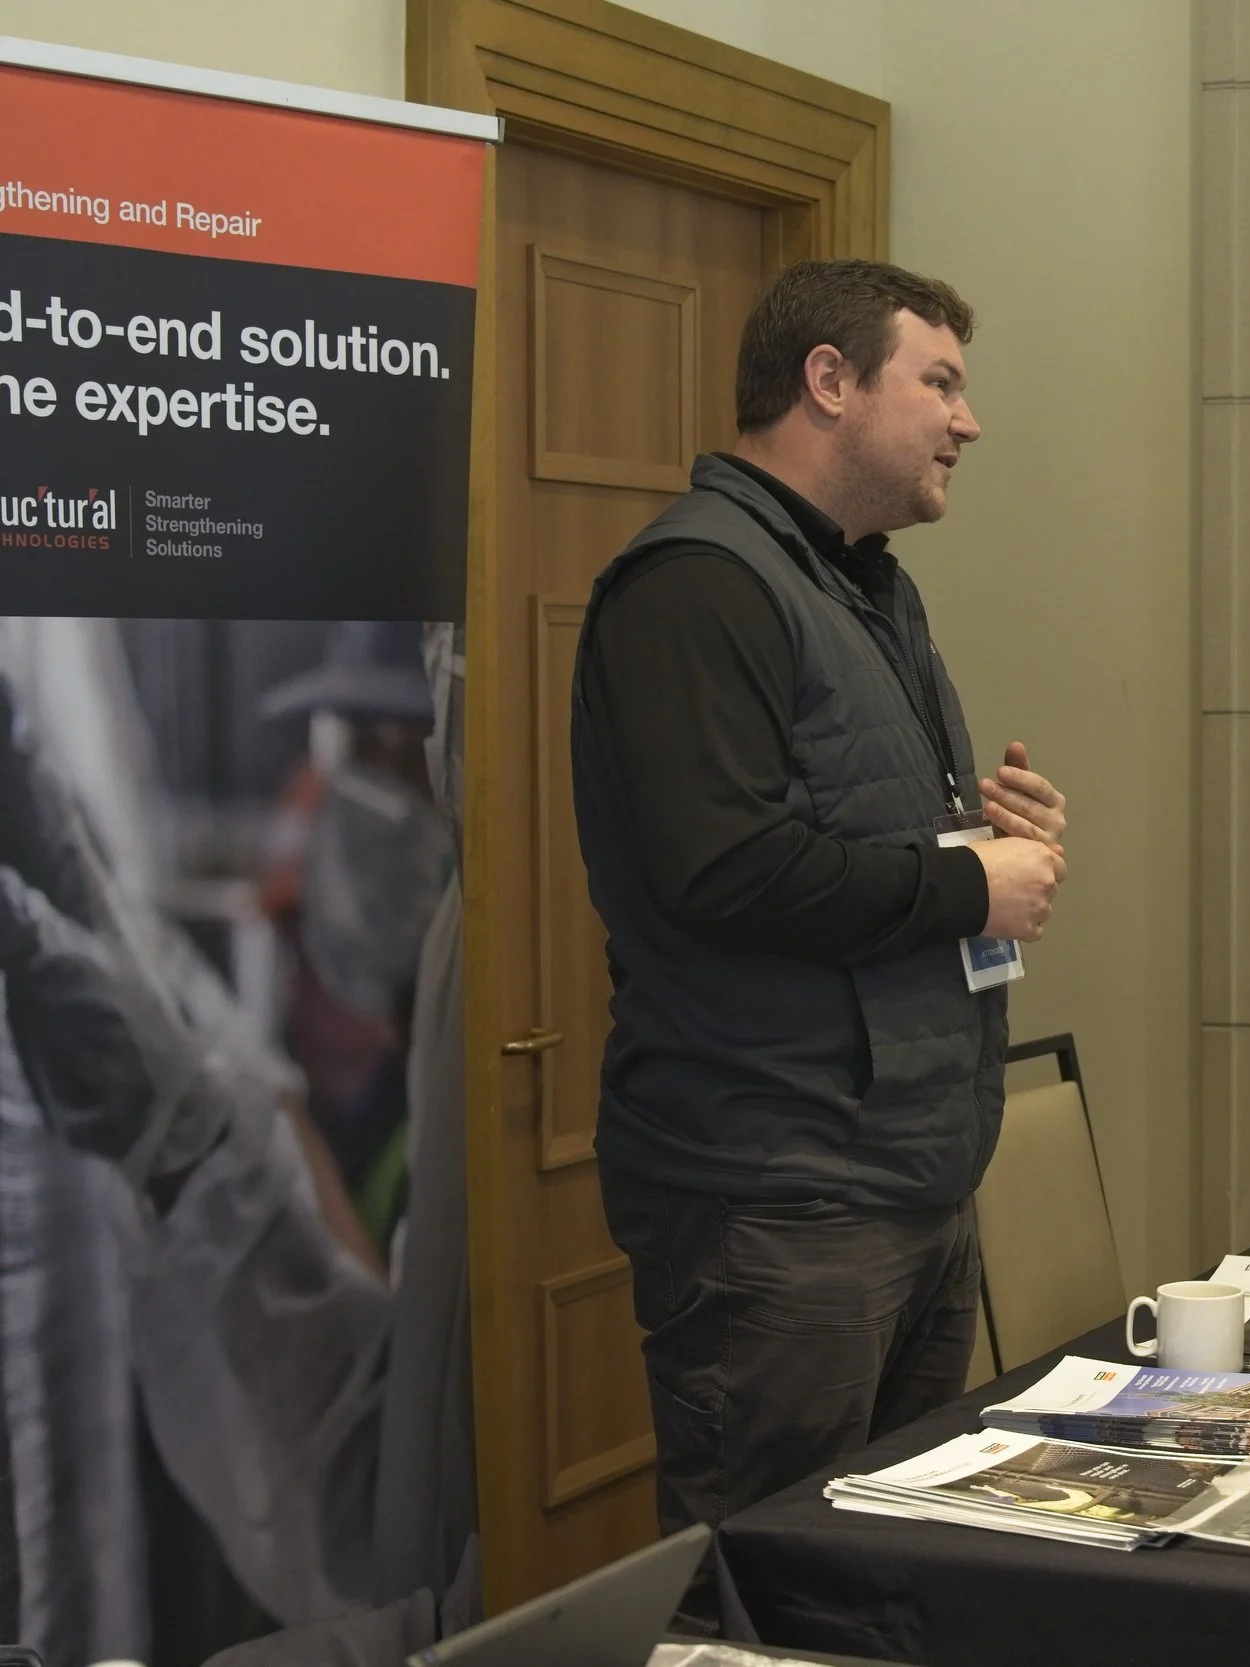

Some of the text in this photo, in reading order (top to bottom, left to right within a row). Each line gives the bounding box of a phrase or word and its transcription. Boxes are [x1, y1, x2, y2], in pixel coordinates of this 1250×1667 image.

[119, 200, 167, 226] and
[176, 202, 262, 239] Repair
[240, 319, 450, 380] solution.
[75, 380, 330, 436] expertise.
[145, 490, 211, 510] Smarter
[145, 514, 264, 539] Strengthening
[146, 538, 223, 558] Solutions
